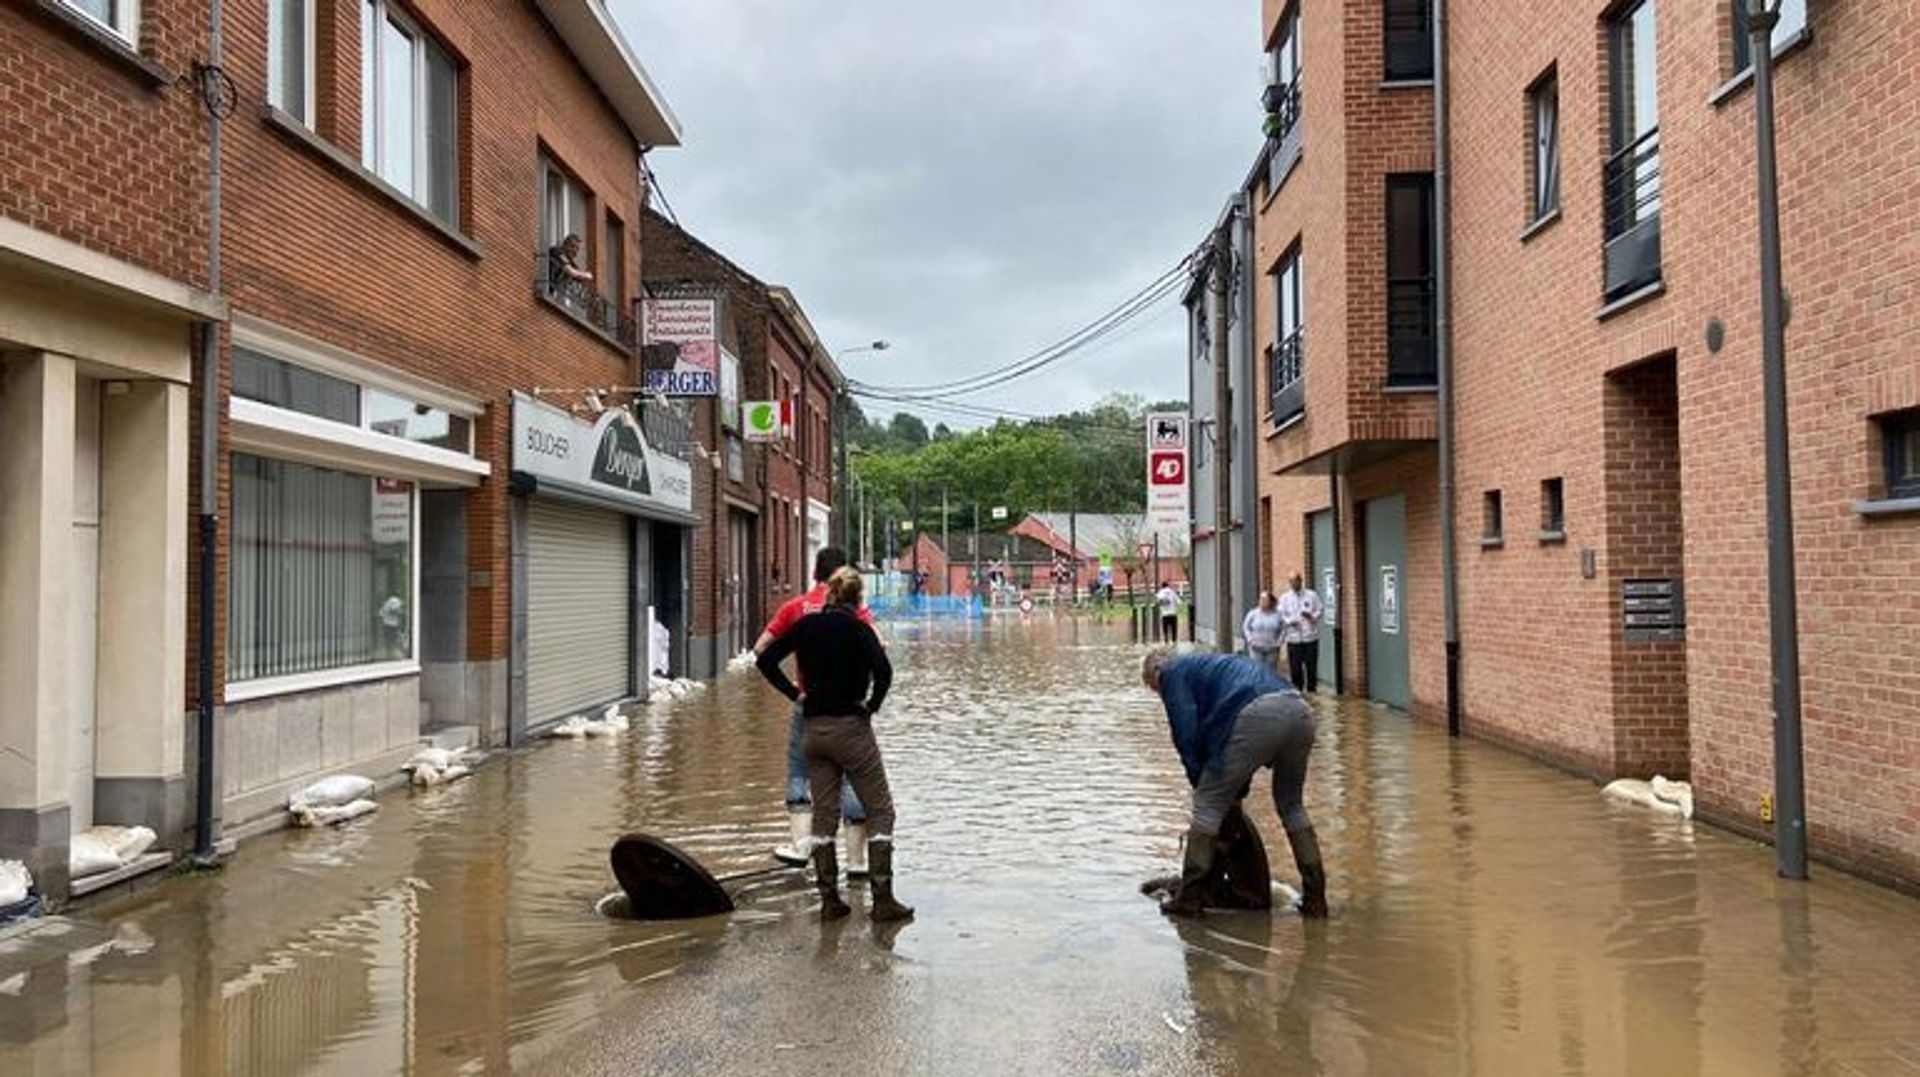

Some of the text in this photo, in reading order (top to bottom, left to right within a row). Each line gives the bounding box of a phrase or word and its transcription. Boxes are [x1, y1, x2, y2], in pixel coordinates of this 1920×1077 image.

[645, 371, 715, 393] BERGER
[527, 425, 570, 459] BOUCHER
[603, 426, 643, 488] Berger
[1156, 459, 1181, 479] AD
